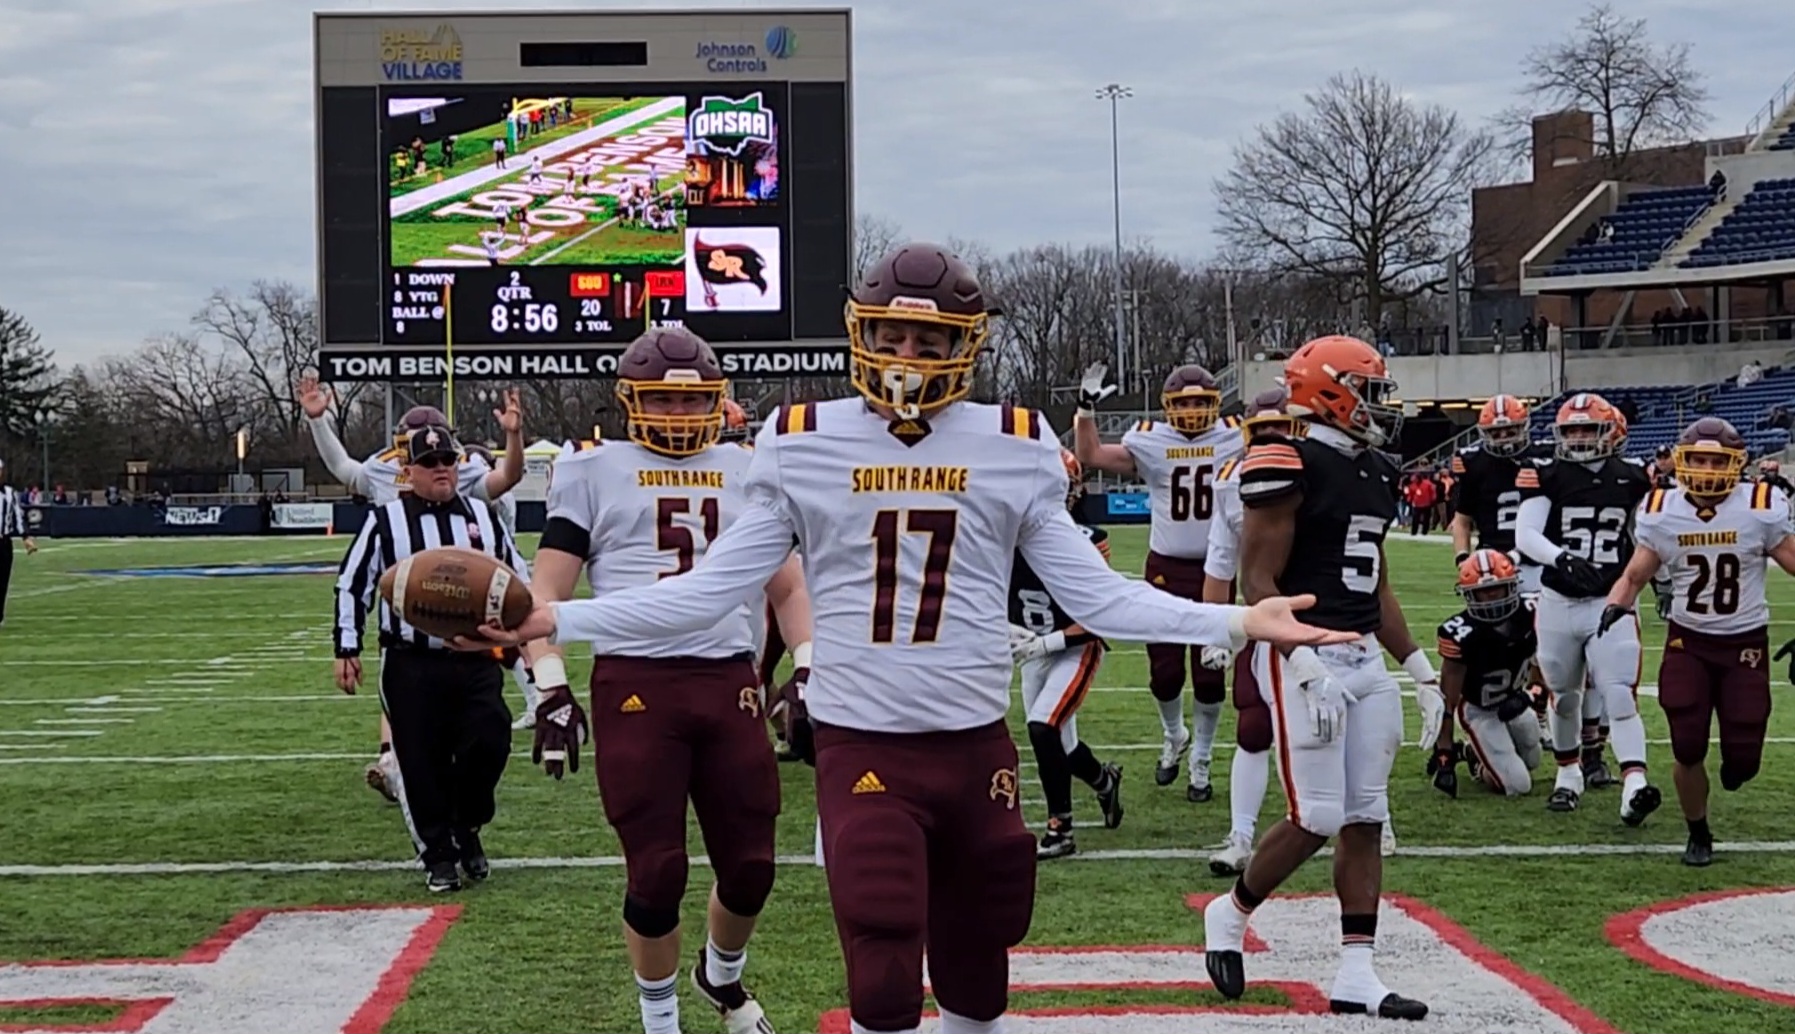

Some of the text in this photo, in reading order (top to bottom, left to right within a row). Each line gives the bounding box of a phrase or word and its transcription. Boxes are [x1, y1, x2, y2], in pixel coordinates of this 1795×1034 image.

[382, 45, 463, 62] OF FAME
[696, 42, 756, 59] Johnson
[382, 62, 464, 80] VILLAGE
[706, 58, 767, 73] Controls
[694, 110, 768, 137] OHSAA
[708, 248, 750, 280] SR
[408, 273, 455, 286] DOWN
[510, 271, 520, 286] 2
[409, 291, 438, 303] YTG
[497, 286, 532, 302] QTR
[392, 306, 430, 319] BALL
[581, 299, 601, 317] 20
[660, 298, 671, 316] 7
[491, 303, 558, 333] 8:56
[586, 320, 612, 332] TOL
[330, 357, 392, 376] TOM
[400, 356, 513, 375] BENSON
[521, 355, 589, 374] HALL
[722, 353, 845, 373] STADIUM
[637, 469, 724, 489] SOUTH RANGE
[852, 466, 968, 493] SOUTH RANGE
[1170, 464, 1214, 521] 66
[656, 496, 719, 580] 51
[1561, 506, 1627, 564] 52
[1341, 514, 1388, 595] 5
[871, 508, 958, 643] 17
[1685, 552, 1740, 615] 28
[1443, 616, 1473, 642] 24
